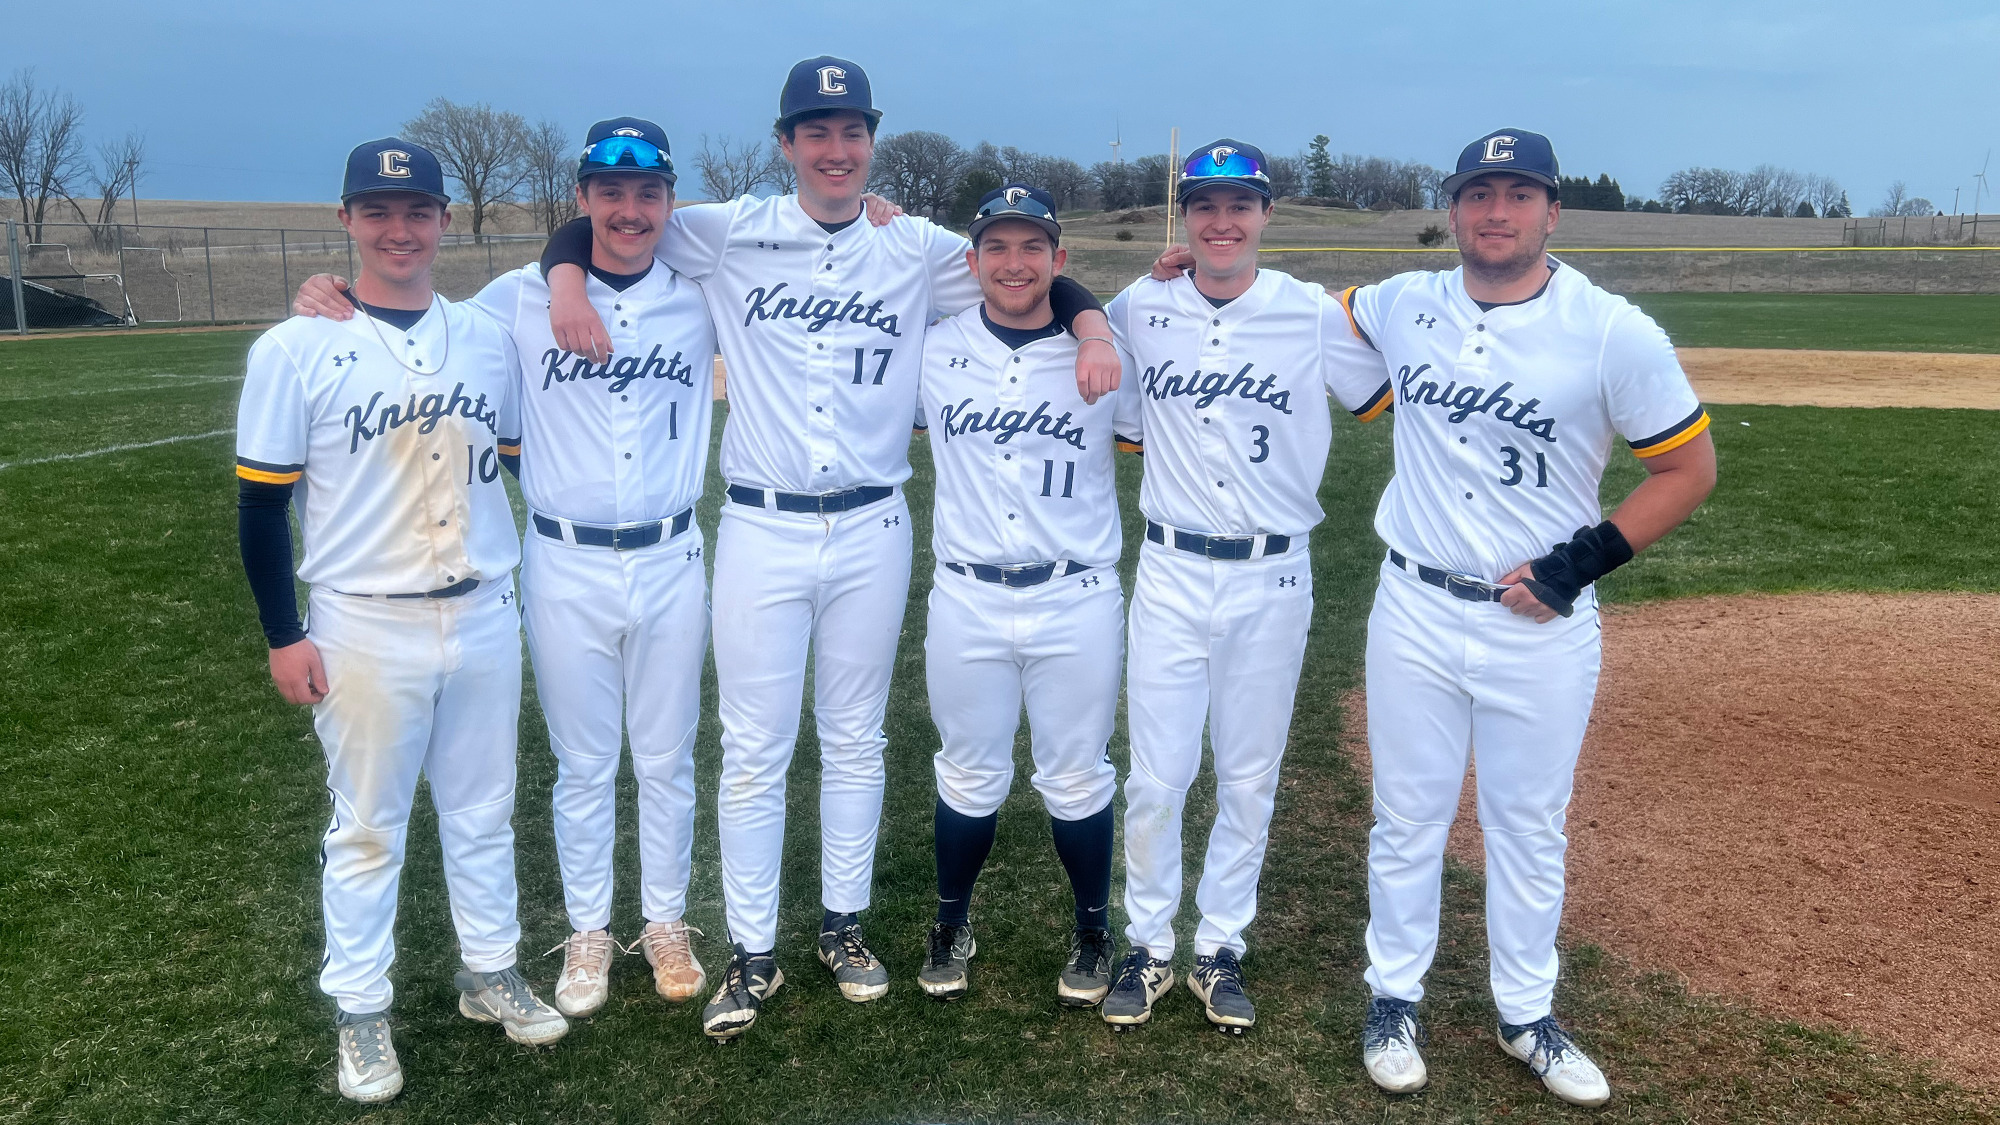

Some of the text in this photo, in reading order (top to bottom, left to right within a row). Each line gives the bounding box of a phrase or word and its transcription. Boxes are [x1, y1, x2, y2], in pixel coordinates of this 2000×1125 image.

[817, 65, 848, 95] C
[377, 149, 412, 178] C
[1480, 135, 1518, 163] C
[744, 282, 902, 337] Knights
[541, 343, 694, 393] Knights
[851, 348, 893, 385] 17
[1142, 360, 1293, 414] Knights
[344, 382, 497, 454] Knights
[668, 401, 679, 440] 1
[940, 397, 1087, 450] Knights
[1398, 363, 1557, 443] Knights
[1249, 424, 1270, 463] 3
[466, 444, 499, 485] 10
[1039, 459, 1075, 498] 11
[1499, 446, 1549, 488] 31
